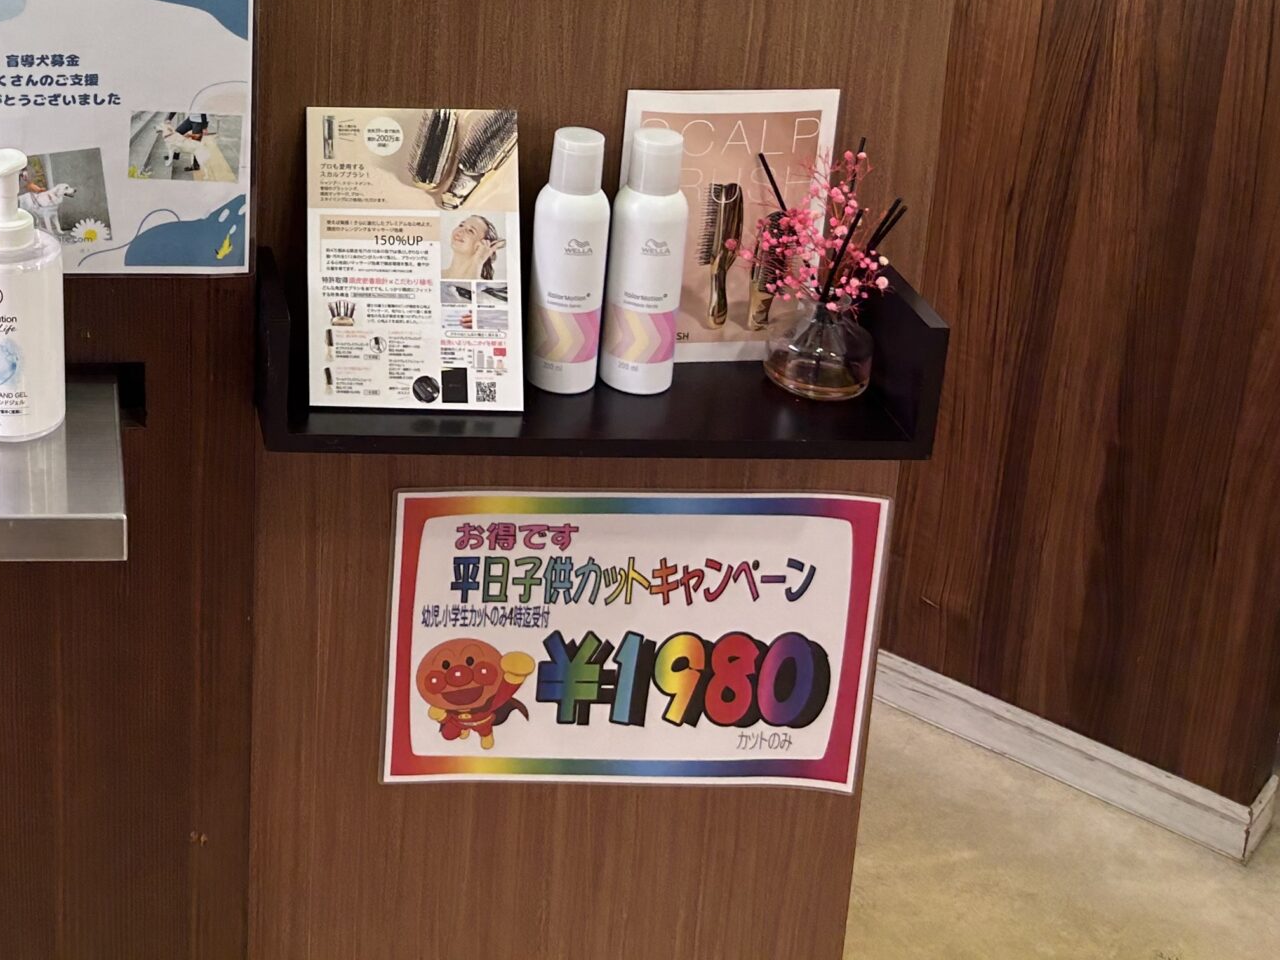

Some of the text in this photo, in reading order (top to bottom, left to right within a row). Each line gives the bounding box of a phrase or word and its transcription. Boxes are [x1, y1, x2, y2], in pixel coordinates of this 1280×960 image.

[5, 53, 81, 69] 盲導犬募金
[374, 234, 424, 246] 150%UP
[15, 391, 28, 399] GEL
[454, 522, 579, 551] お得です
[450, 556, 817, 606] 平日子供カットキャンペーン
[535, 629, 831, 729] ¥1980
[736, 731, 792, 751] カットのみ
